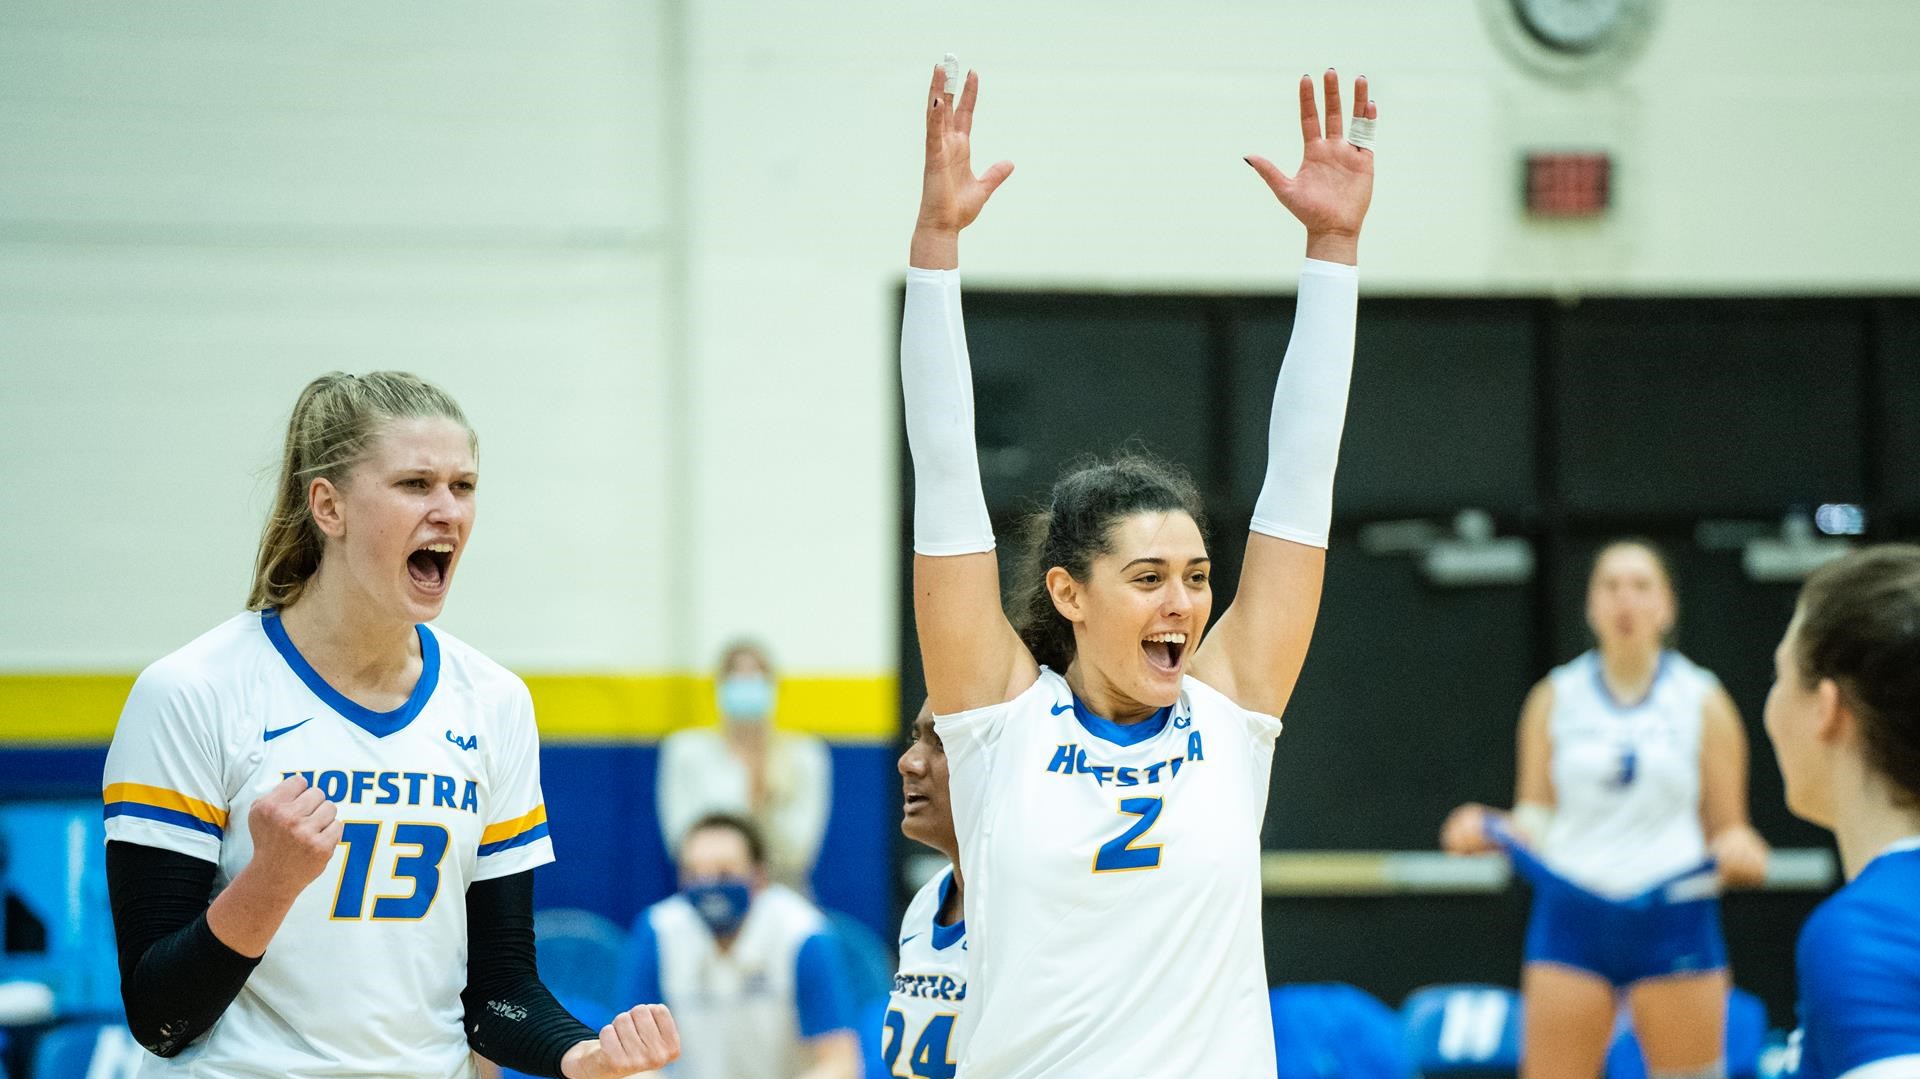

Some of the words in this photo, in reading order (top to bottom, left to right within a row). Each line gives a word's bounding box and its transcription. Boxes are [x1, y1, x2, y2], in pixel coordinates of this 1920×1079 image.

[329, 820, 450, 921] 13
[1092, 795, 1164, 874] 2
[882, 1007, 959, 1079] 24
